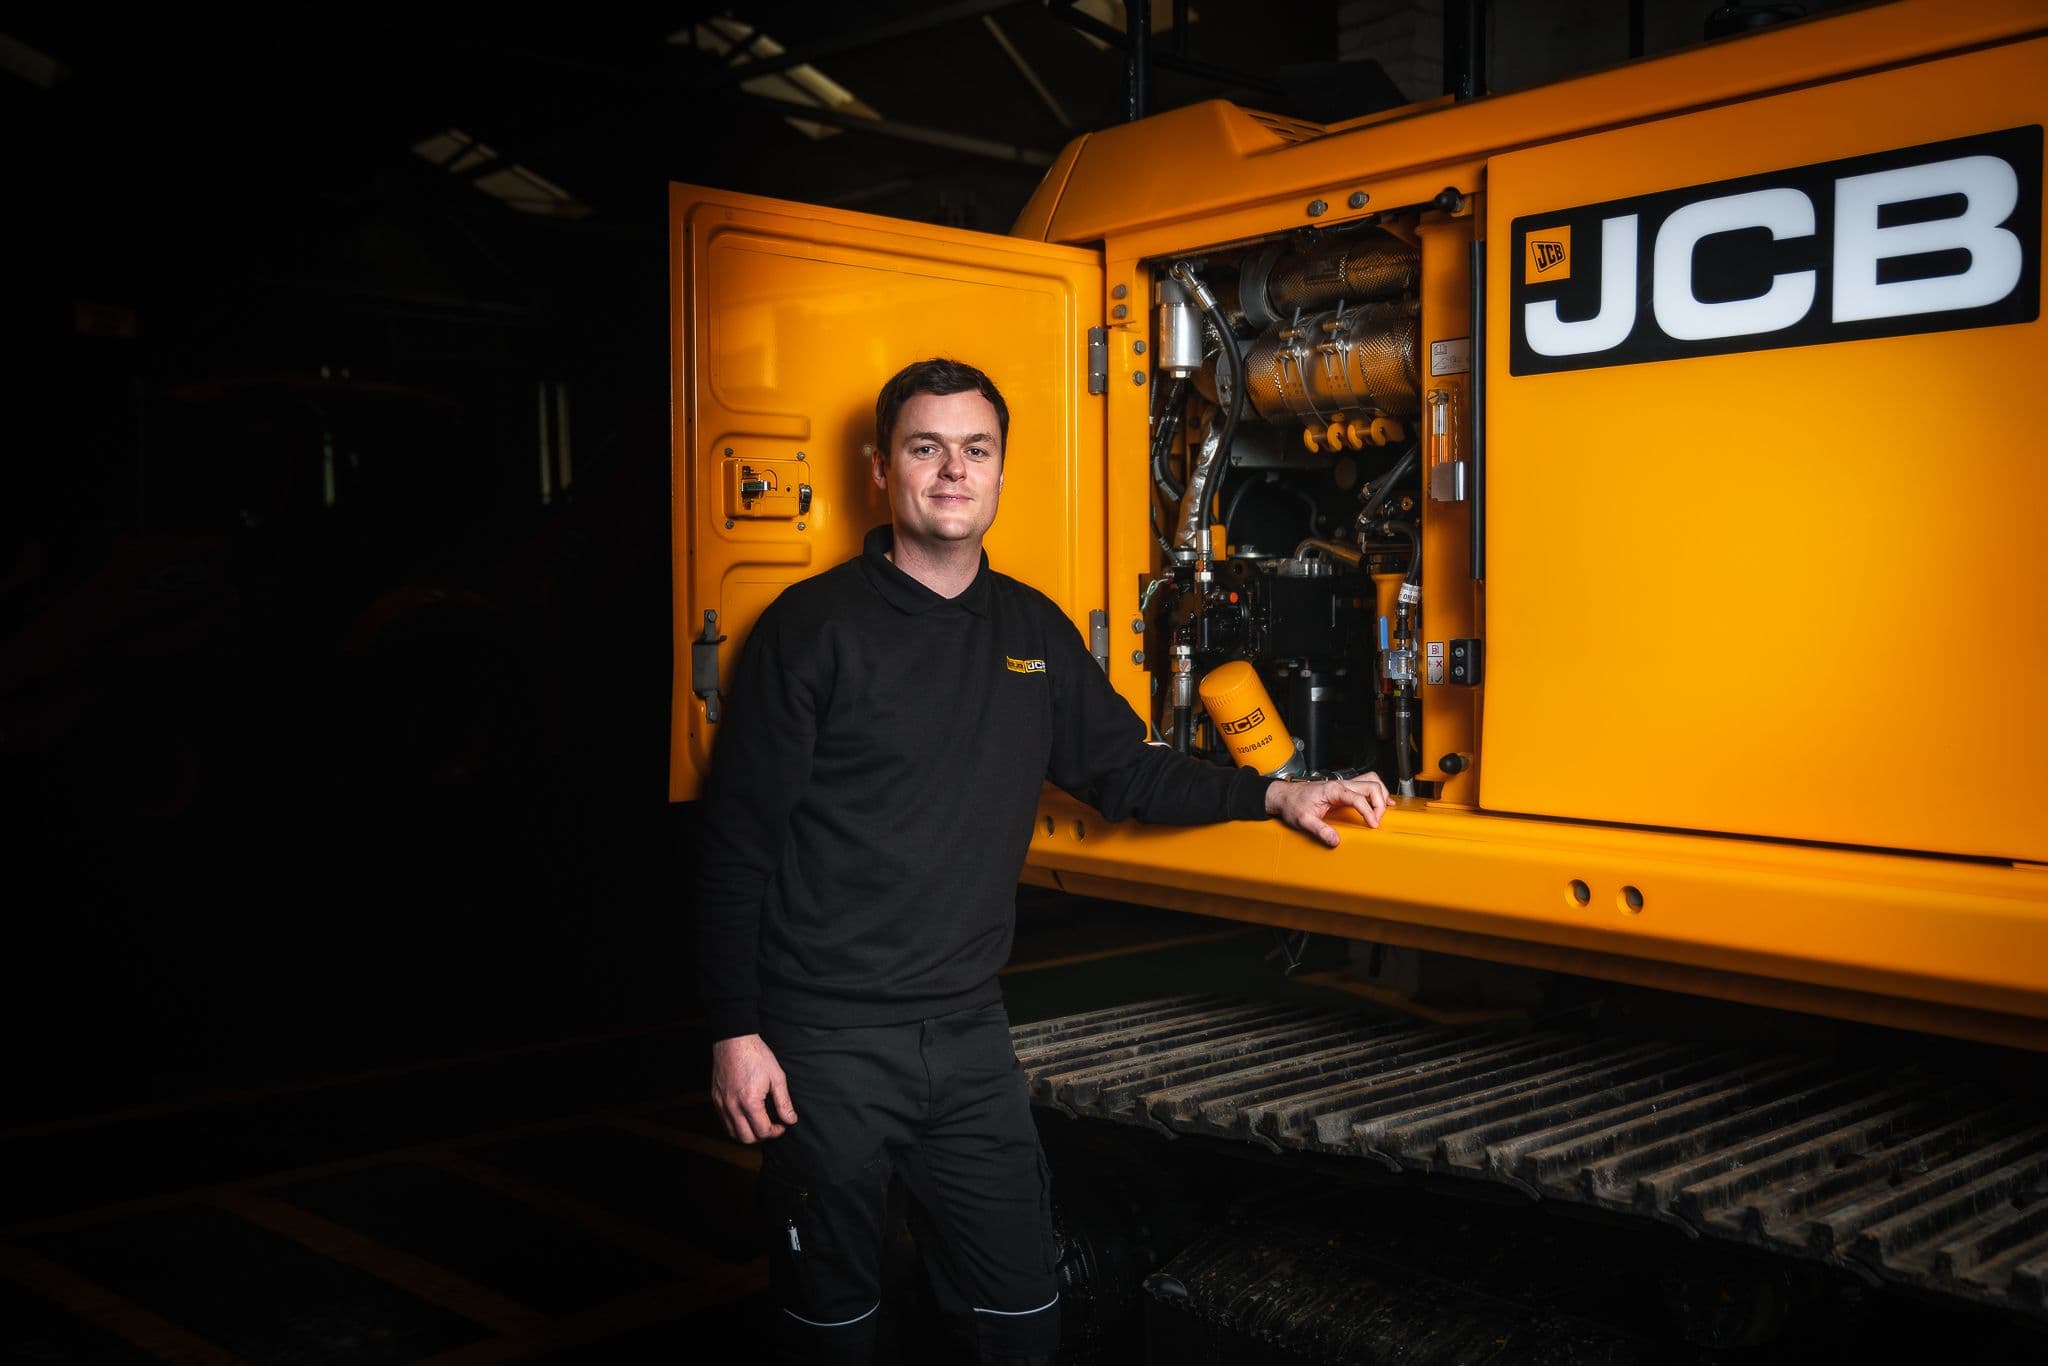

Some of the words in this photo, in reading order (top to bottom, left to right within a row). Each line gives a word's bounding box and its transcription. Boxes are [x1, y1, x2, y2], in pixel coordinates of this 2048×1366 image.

[1525, 155, 2023, 357] JCB
[1536, 243, 1564, 269] JCB
[1222, 709, 1264, 734] JCB
